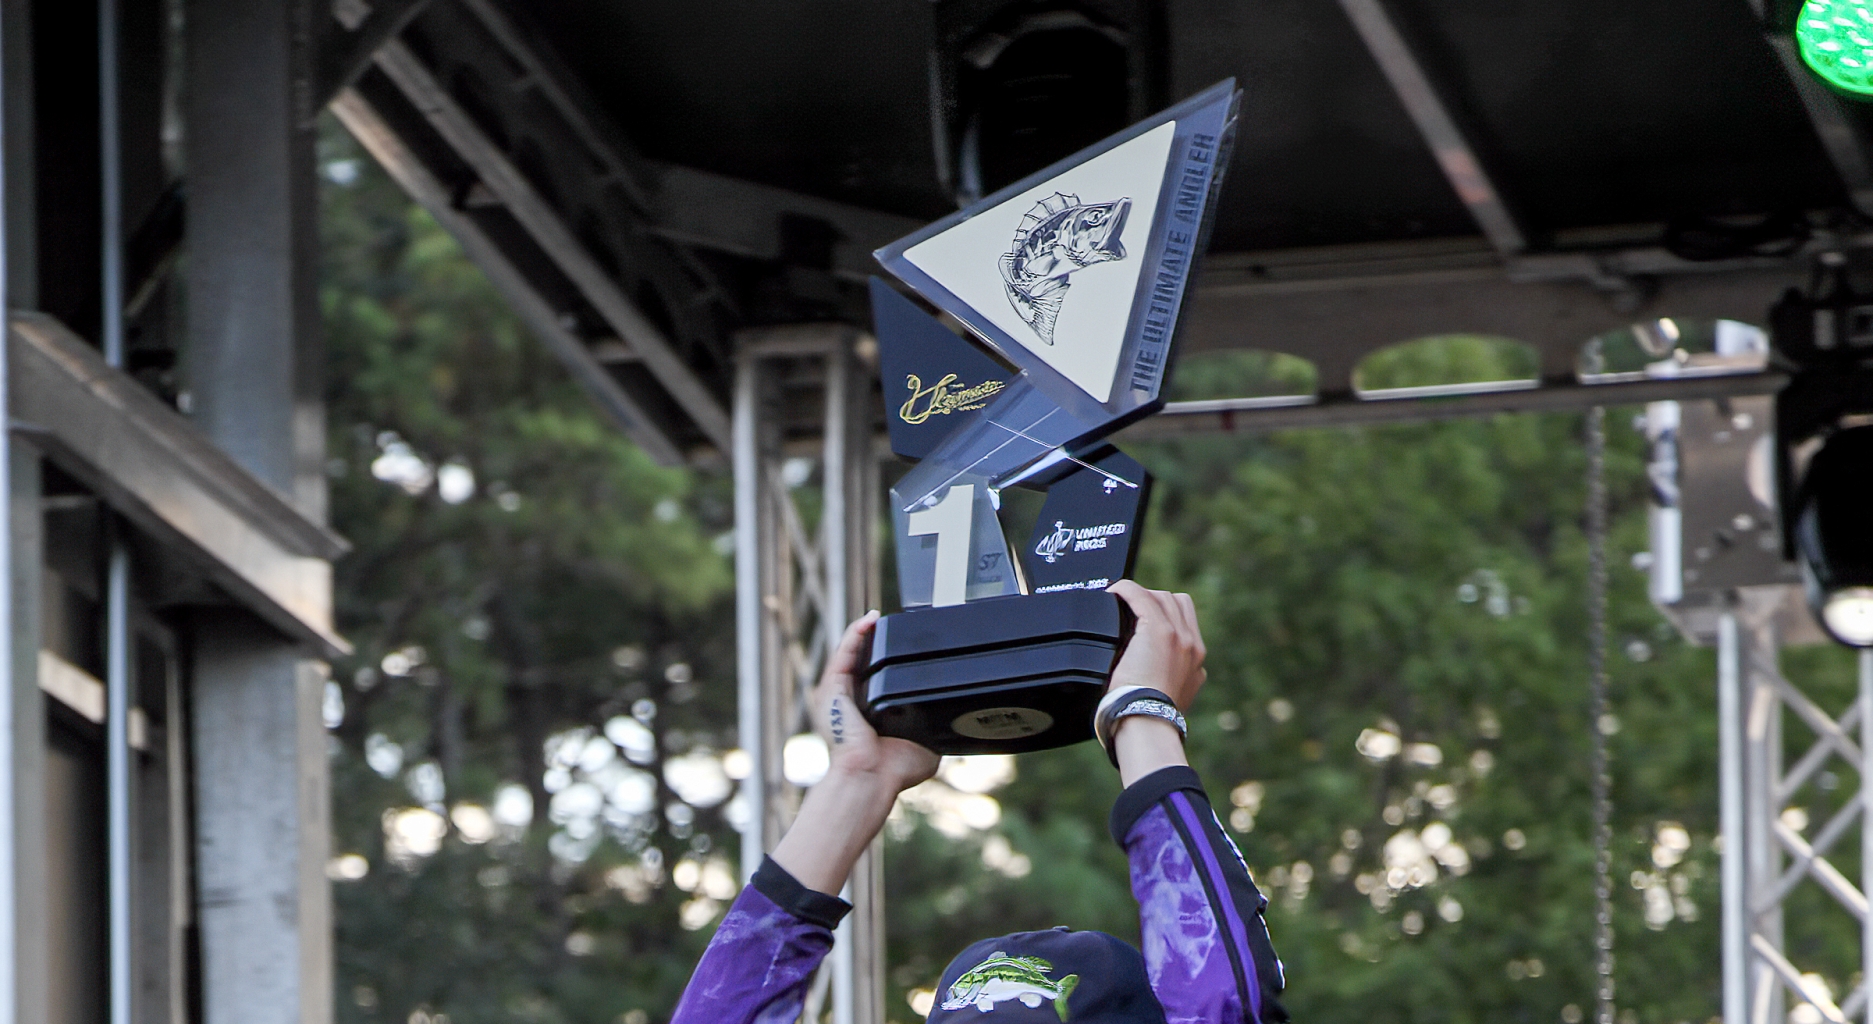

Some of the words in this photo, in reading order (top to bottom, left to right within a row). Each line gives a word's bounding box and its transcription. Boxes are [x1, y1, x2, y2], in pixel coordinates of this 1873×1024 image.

[1142, 229, 1189, 345] ULTIMATE
[1129, 349, 1159, 393] THE
[907, 483, 975, 609] 1
